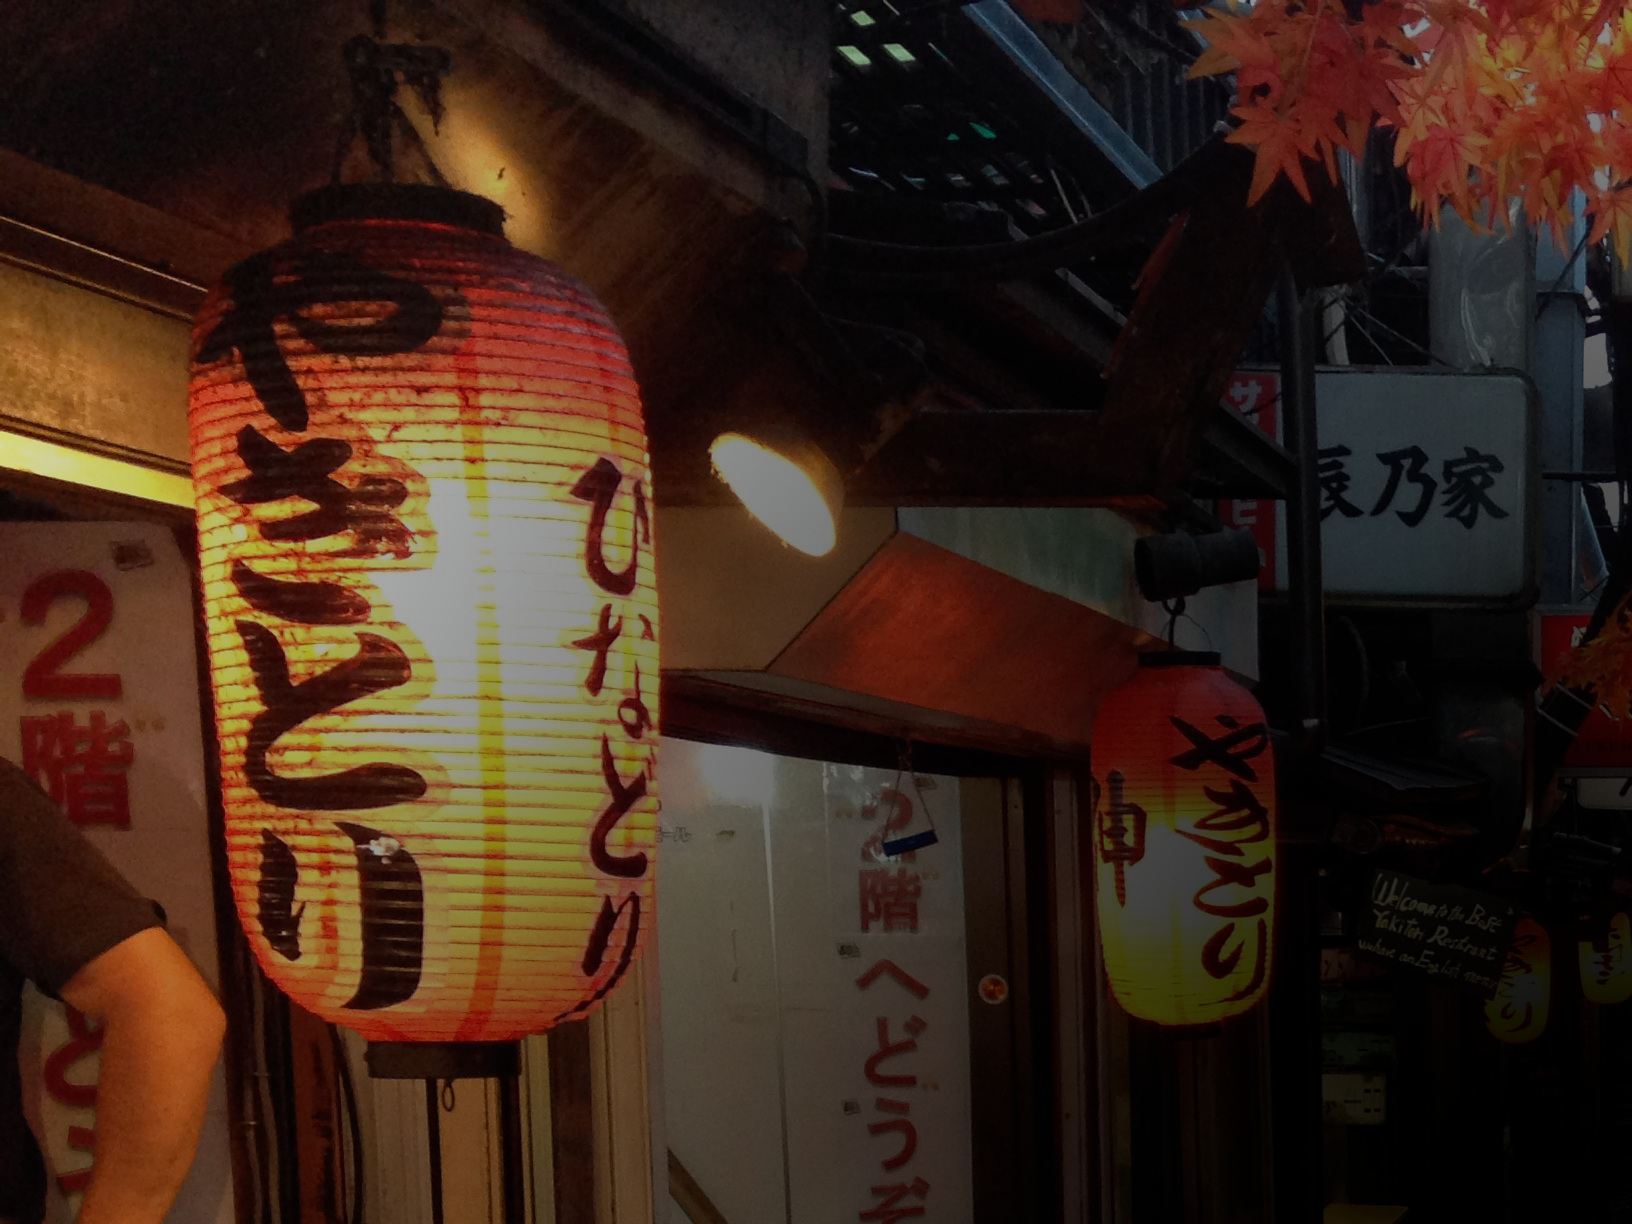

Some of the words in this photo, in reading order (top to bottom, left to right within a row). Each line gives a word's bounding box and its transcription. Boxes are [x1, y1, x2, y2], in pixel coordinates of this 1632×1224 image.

[196, 248, 446, 1011] やきとり
[1169, 714, 1273, 1007] やきとり
[1372, 873, 1437, 916] Welcome
